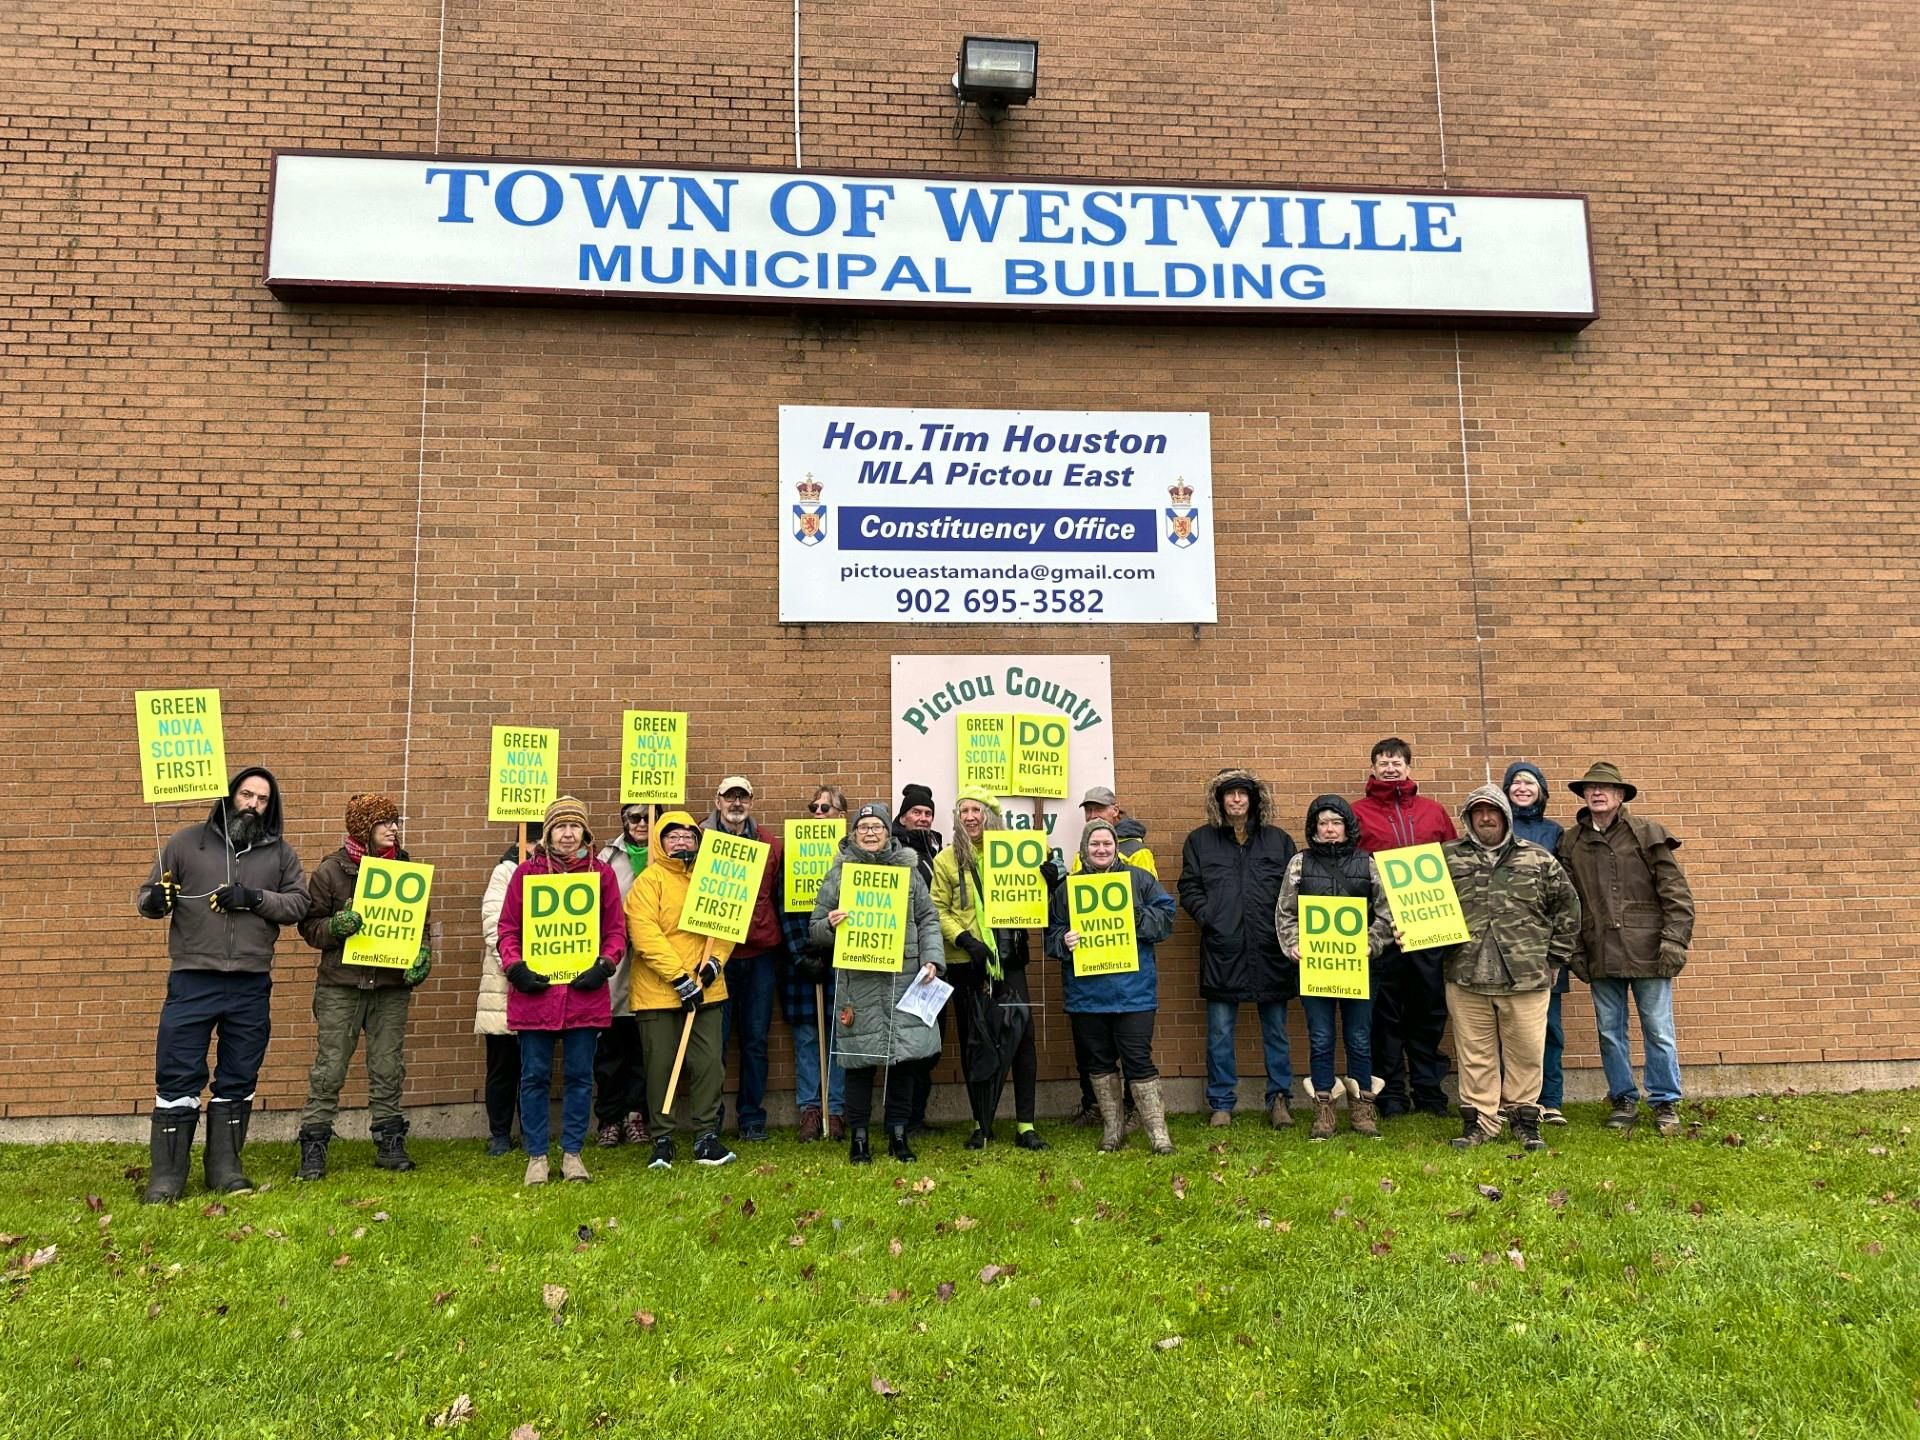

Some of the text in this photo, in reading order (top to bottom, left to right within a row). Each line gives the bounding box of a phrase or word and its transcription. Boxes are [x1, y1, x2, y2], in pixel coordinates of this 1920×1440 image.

[426, 167, 1463, 253] TOWN OF WESTVILLE
[579, 244, 1327, 300] MUNICIPAL BUILDING
[1003, 425, 1168, 454] Houston
[858, 461, 1134, 487] MLA Pictou East
[860, 515, 1136, 545] Constituency Office
[841, 563, 1155, 583] pictoueastamanda@gmail.com
[896, 589, 1104, 614] 902 695-3582
[151, 697, 206, 715] GREEN
[902, 667, 1103, 735] Pictou County
[159, 719, 203, 736] NOVA
[634, 717, 676, 732] GREEN
[967, 718, 1003, 731] GREEN
[504, 733, 547, 749] GREEN
[638, 735, 671, 749] NOVA
[971, 734, 1000, 747] NOVA
[1020, 721, 1065, 747] DO
[151, 739, 213, 758] SCOTIA
[965, 750, 1006, 763] SCOTIA
[1022, 750, 1060, 762] WIND
[507, 751, 542, 766] NOVA
[630, 752, 677, 768] SCOTIA
[156, 760, 212, 779] FIRST!
[500, 769, 548, 784] SCOTIA
[632, 770, 674, 785] FIRST!
[968, 766, 1005, 779] FIRST!
[1019, 763, 1063, 776] RIGHT!
[154, 783, 218, 794] GreenNSfirst.ca
[501, 787, 545, 803] FIRST!
[628, 790, 677, 798] GreenNSfirst.ca
[1019, 786, 1062, 795] GreenNSfirst.ca
[497, 807, 544, 815] GreenNSfirst.c
[795, 825, 836, 839] GREEN
[711, 838, 758, 863] GREEN
[800, 843, 832, 857] NOVA
[990, 840, 1043, 868] DO
[711, 859, 747, 881] NOVA
[793, 861, 830, 875] SCOTI
[1384, 853, 1444, 889] DO
[363, 867, 426, 904] DO
[795, 878, 823, 893] FIRS
[853, 870, 899, 889] GREEN
[994, 873, 1037, 886] WIND
[699, 877, 749, 902] SCOTIA
[991, 889, 1041, 902] RIGHT!
[1398, 888, 1445, 907] WIND
[531, 883, 594, 918] DO
[856, 891, 892, 909] NOVA
[1074, 882, 1128, 914] DO
[364, 905, 414, 923] WIND
[695, 896, 742, 921] FIRST!
[1400, 904, 1456, 924] RIGHT!
[688, 916, 740, 935] GreenNSfirst.ca
[847, 910, 897, 929] SCOTIA
[992, 916, 1041, 924] GreenNSfirst.ca
[1080, 917, 1125, 932] WIND
[1305, 905, 1363, 937] DO
[535, 922, 587, 938] WIND
[531, 939, 591, 956] RIGHT!
[847, 931, 893, 950] FIRST!
[1079, 933, 1130, 949] RIGHT!
[1409, 932, 1463, 947] GreenNSfirst.ca
[1309, 941, 1357, 955] WIND
[352, 952, 409, 965] GreenNSfirst.ca
[842, 952, 895, 965] GreenNSfirst.ca
[1082, 961, 1131, 972] GreenNSfirst.ca
[1306, 957, 1362, 971] RIGHT!
[1307, 984, 1361, 995] GreenNSfirst.ca
